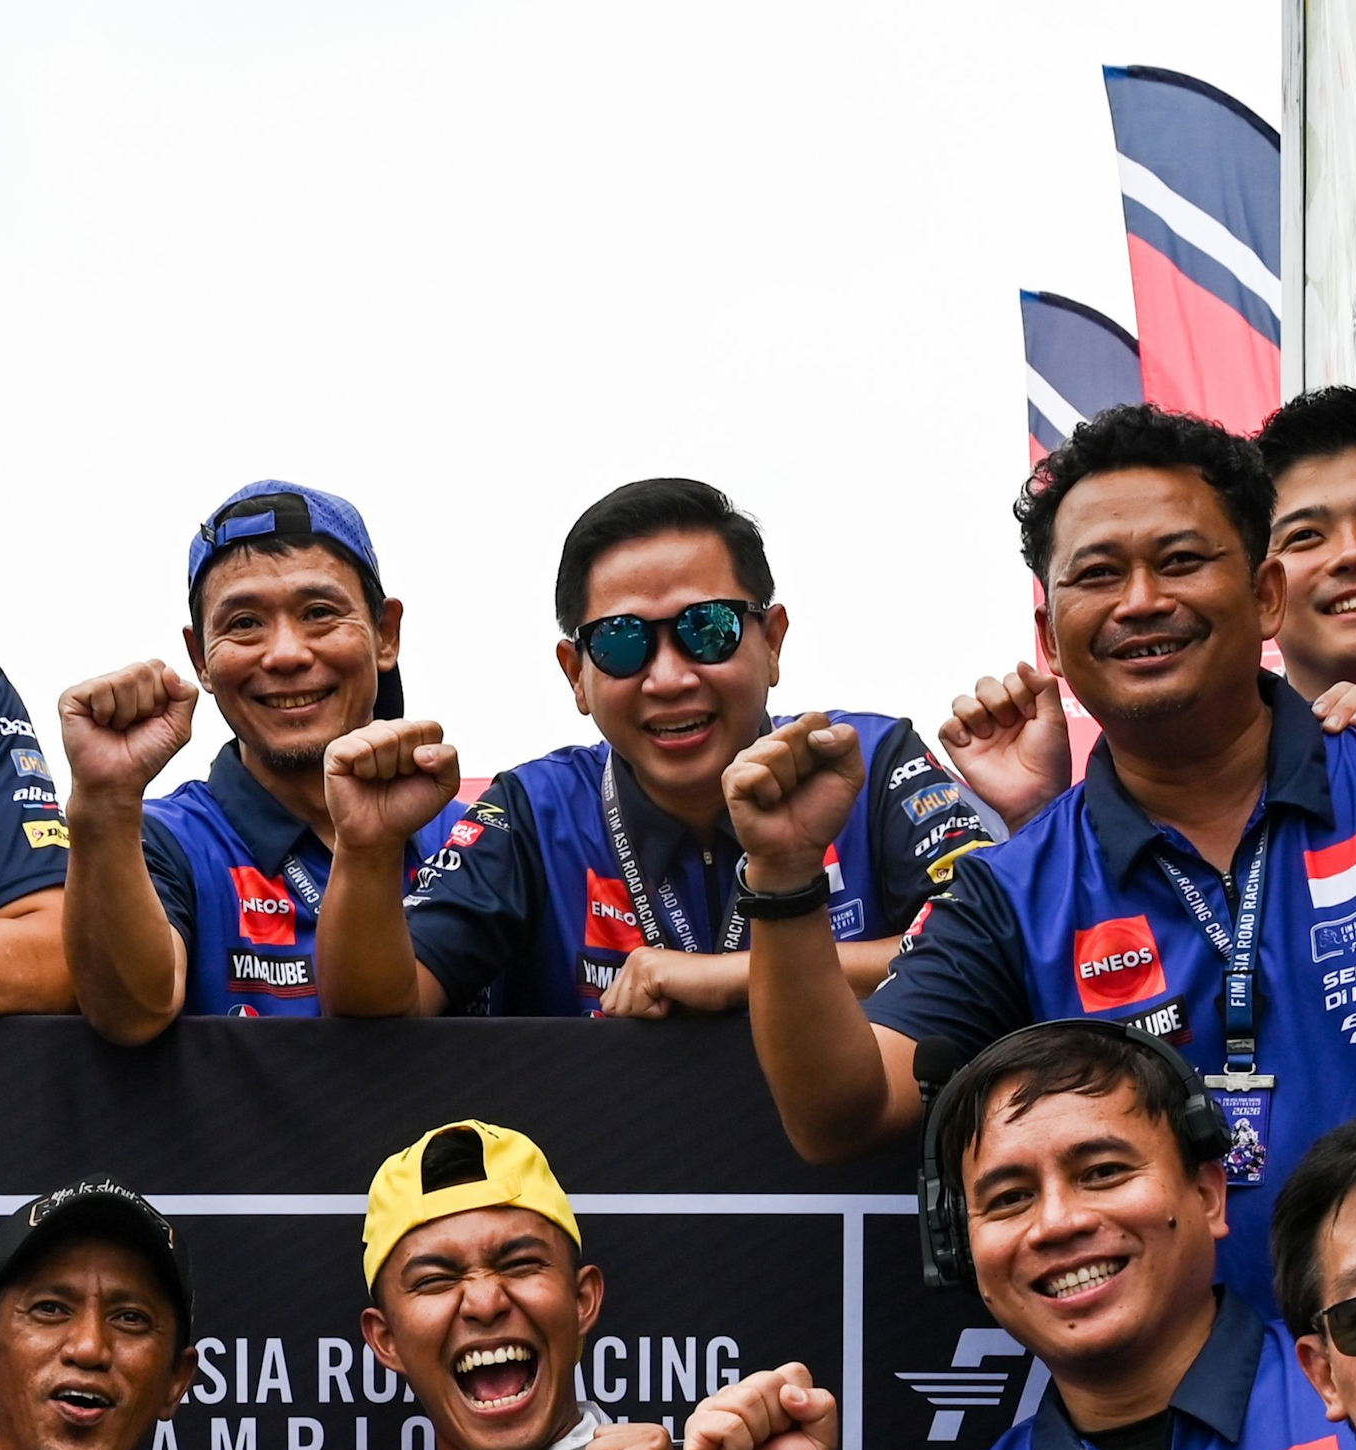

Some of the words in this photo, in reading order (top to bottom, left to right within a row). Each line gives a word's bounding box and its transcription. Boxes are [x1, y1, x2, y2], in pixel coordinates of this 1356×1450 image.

[608, 806, 622, 831] FIM
[614, 832, 631, 861] ASIA
[622, 858, 643, 894] ROAD
[1243, 859, 1261, 909] RACING
[1177, 876, 1213, 922] RACING
[634, 895, 660, 941] RACING
[669, 908, 698, 953] RACING
[1237, 913, 1256, 949] ROAD
[1080, 947, 1153, 980] ENEOS
[1231, 981, 1246, 1007] FIM
